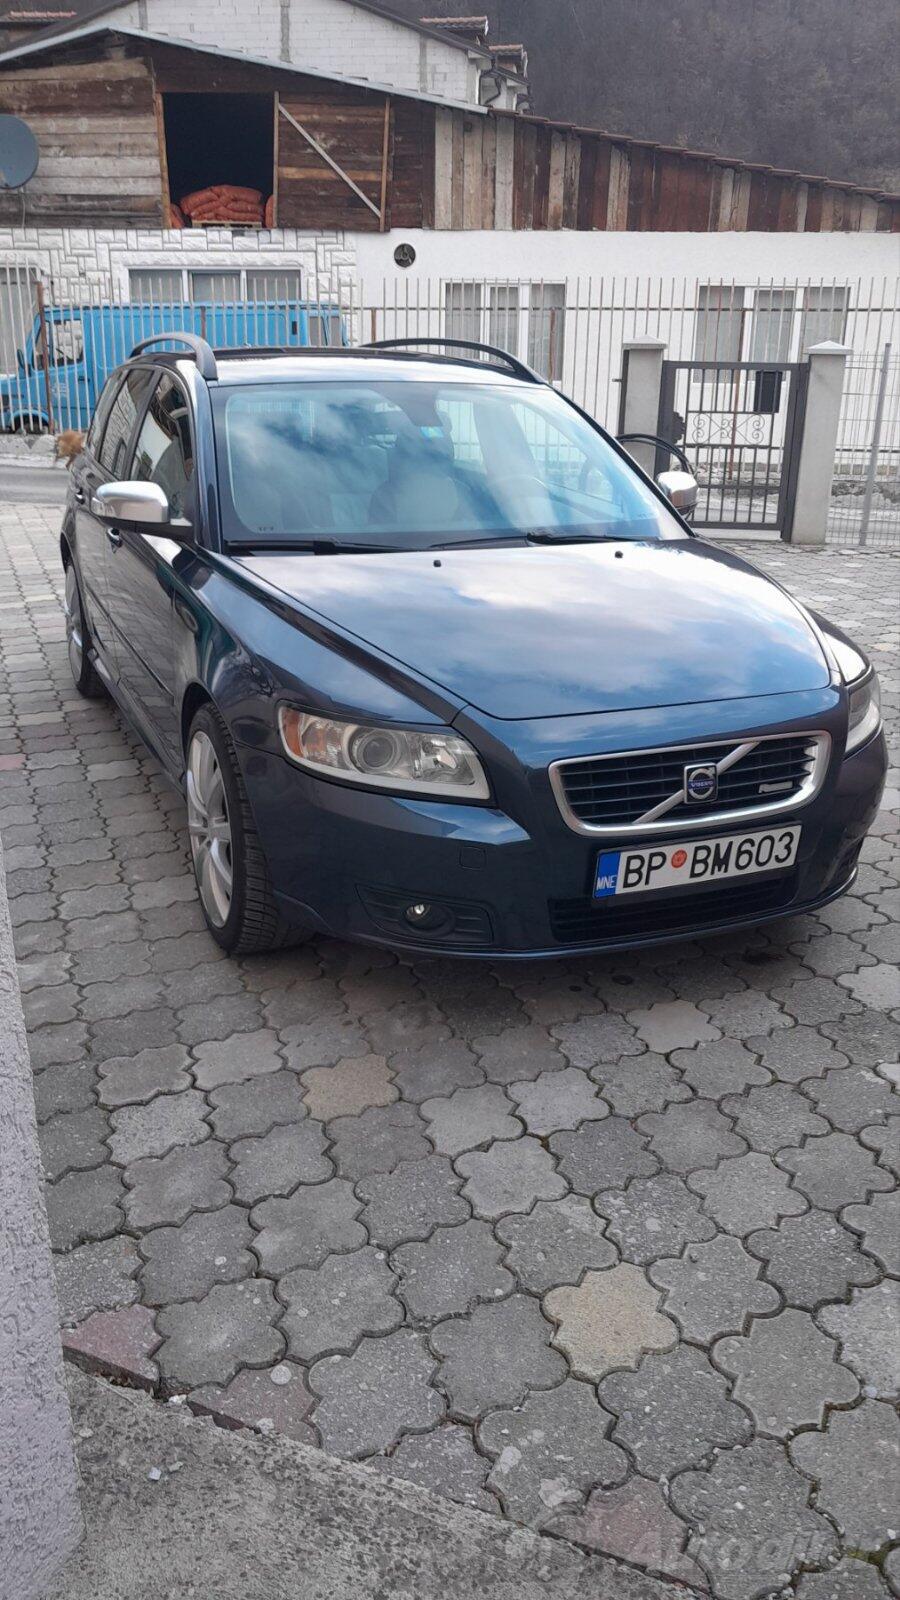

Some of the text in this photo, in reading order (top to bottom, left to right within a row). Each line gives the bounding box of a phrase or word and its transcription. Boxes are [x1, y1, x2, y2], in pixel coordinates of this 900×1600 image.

[623, 831, 795, 888] BP BM603
[596, 874, 617, 891] MNE
